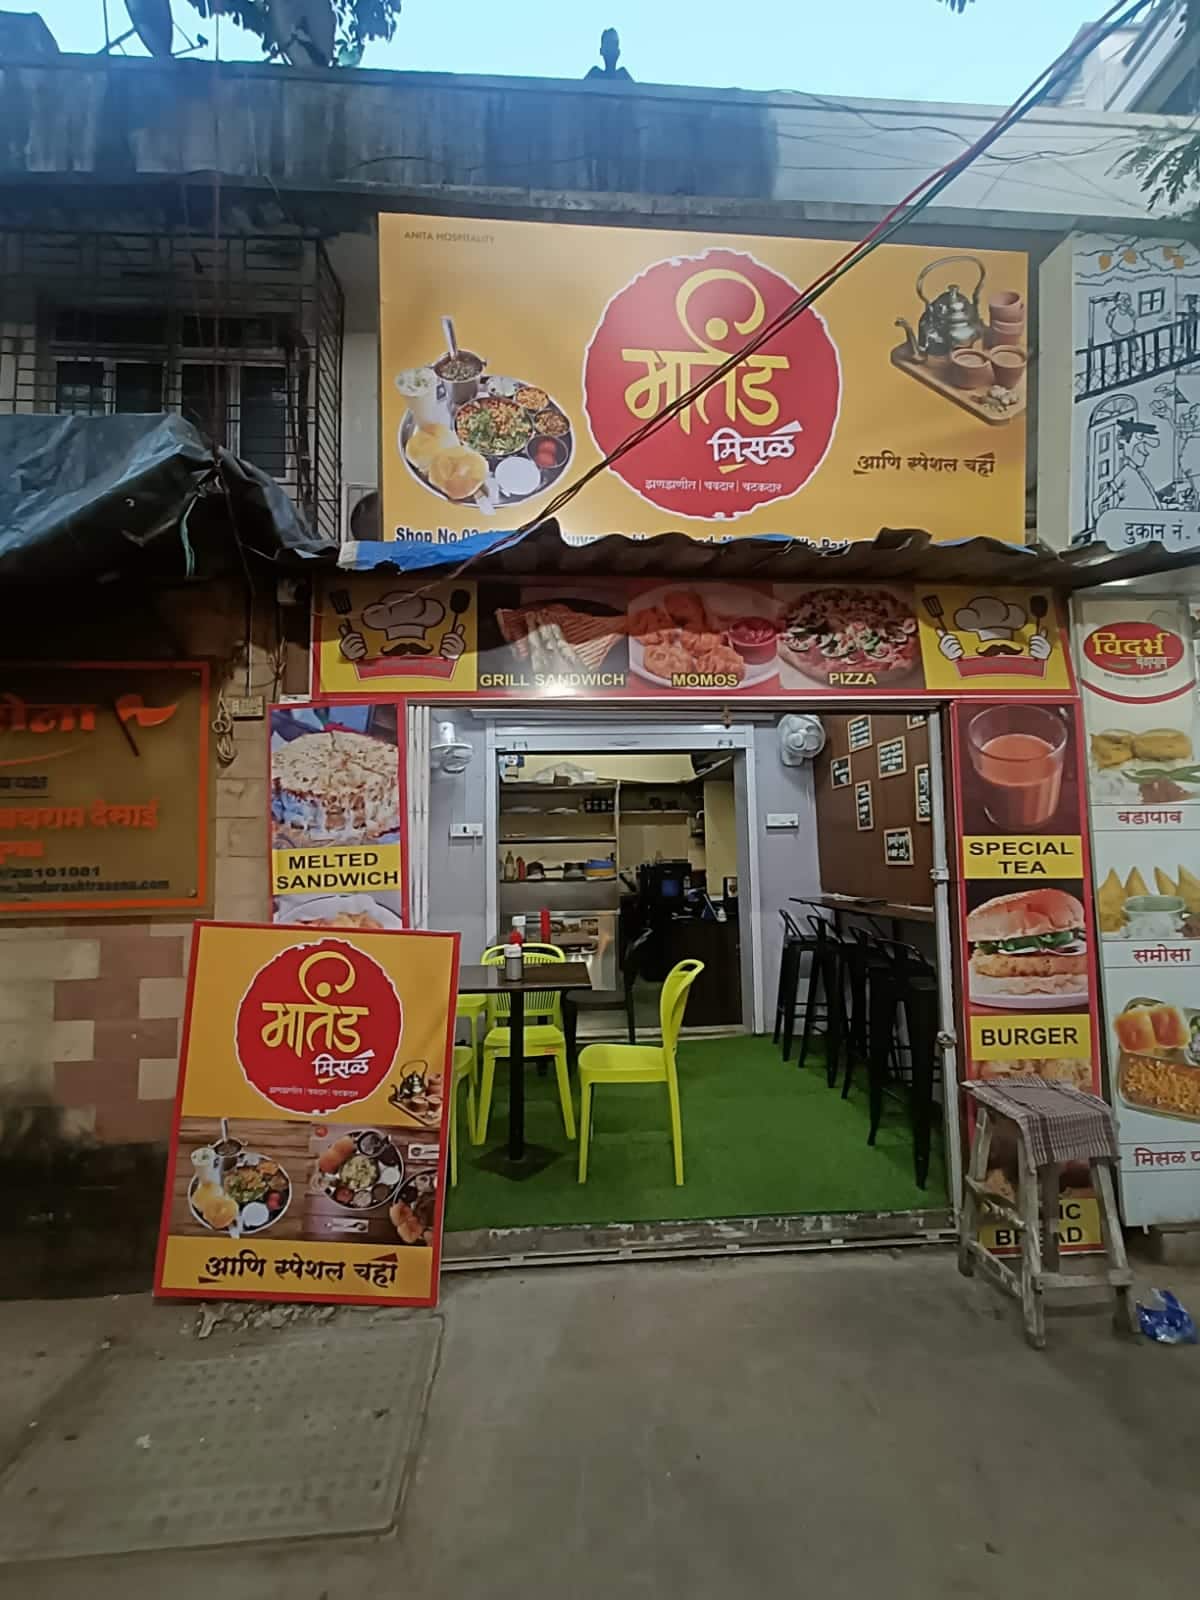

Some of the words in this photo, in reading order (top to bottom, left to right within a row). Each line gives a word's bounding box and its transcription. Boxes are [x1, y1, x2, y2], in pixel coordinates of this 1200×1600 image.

[403, 231, 434, 241] ANITA
[857, 450, 901, 472] आणि
[907, 452, 958, 472] स्पेशल
[1123, 522, 1167, 545] दुकान
[1092, 632, 1170, 657] विदर्भ
[479, 673, 529, 687] GRILL
[535, 673, 625, 687] SANDWICH
[672, 673, 738, 687] MOMOS
[828, 672, 877, 686] PIZZA
[1116, 811, 1183, 825] वडापाव
[969, 842, 1074, 856] SPECIAL
[288, 852, 379, 870] MELTED
[998, 861, 1047, 875] TEA
[276, 871, 399, 890] SANDWICH
[1132, 944, 1192, 964] समोसा
[980, 1027, 1079, 1047] BURGER
[1133, 1147, 1186, 1167] मिसळ
[205, 1249, 267, 1278] आणि
[274, 1252, 346, 1282] स्पेशल
